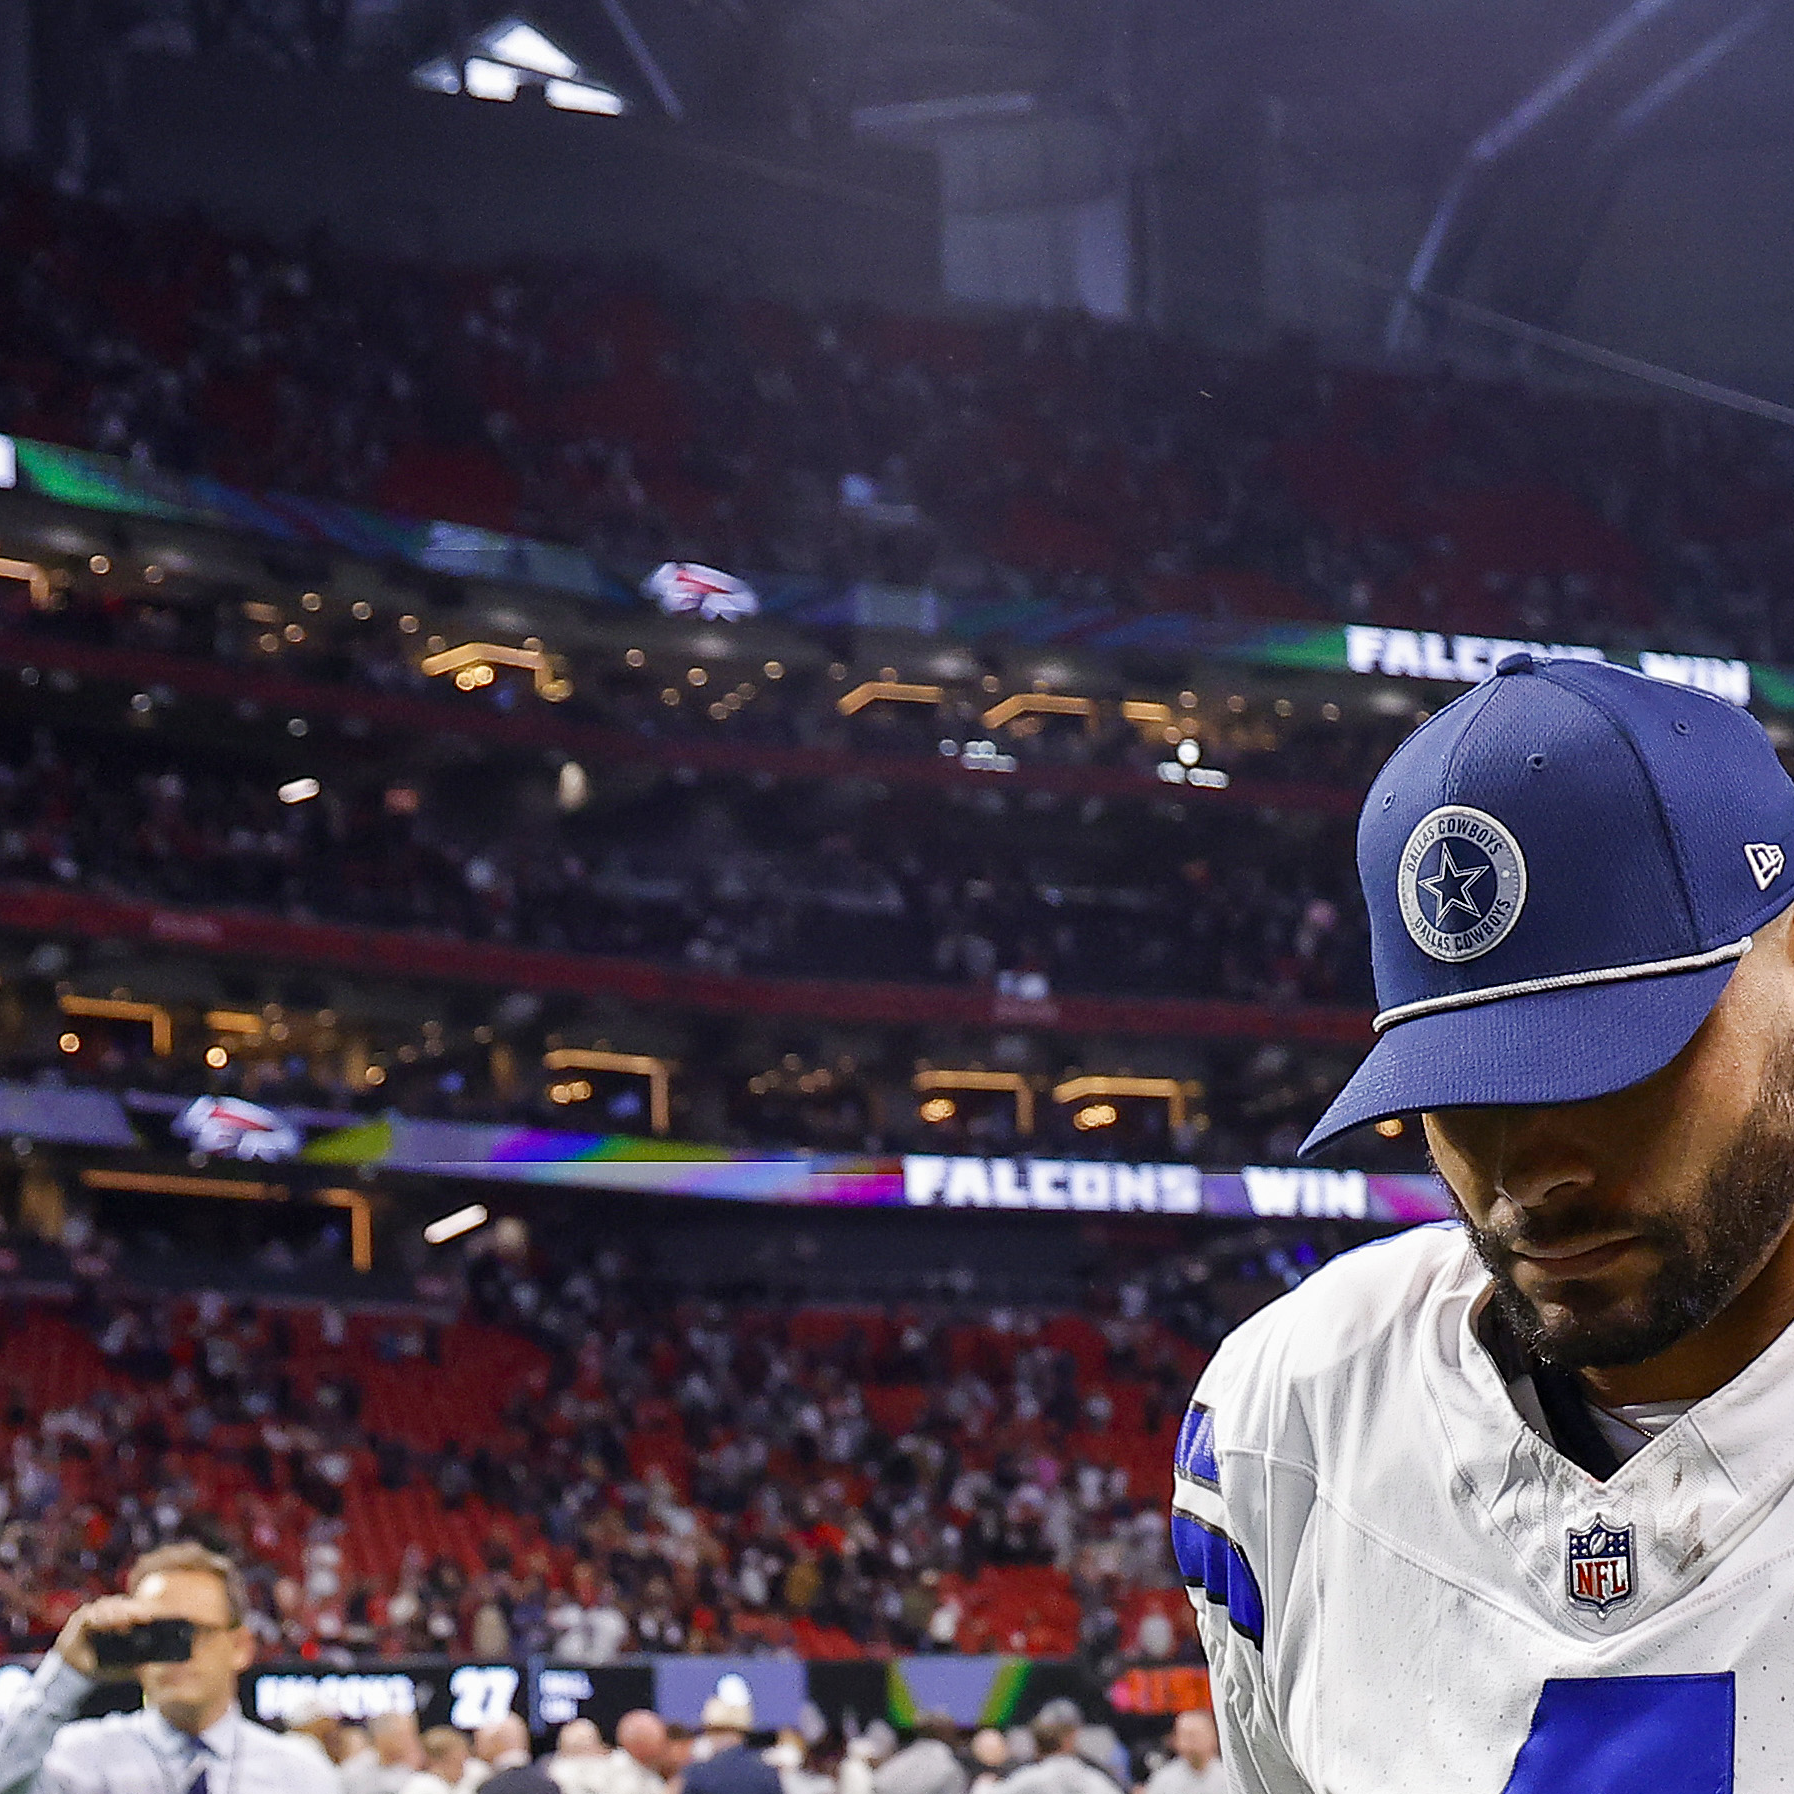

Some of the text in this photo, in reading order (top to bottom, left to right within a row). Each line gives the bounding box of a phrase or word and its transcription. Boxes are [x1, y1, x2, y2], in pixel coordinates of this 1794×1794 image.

[1346, 623, 1603, 685] FALC
[1406, 818, 1503, 873] DALLAS COWBOYS
[1414, 898, 1511, 952] DALLAS COWBOYS
[904, 1153, 1368, 1219] FALCONS WIN
[1575, 1560, 1627, 1600] NFL
